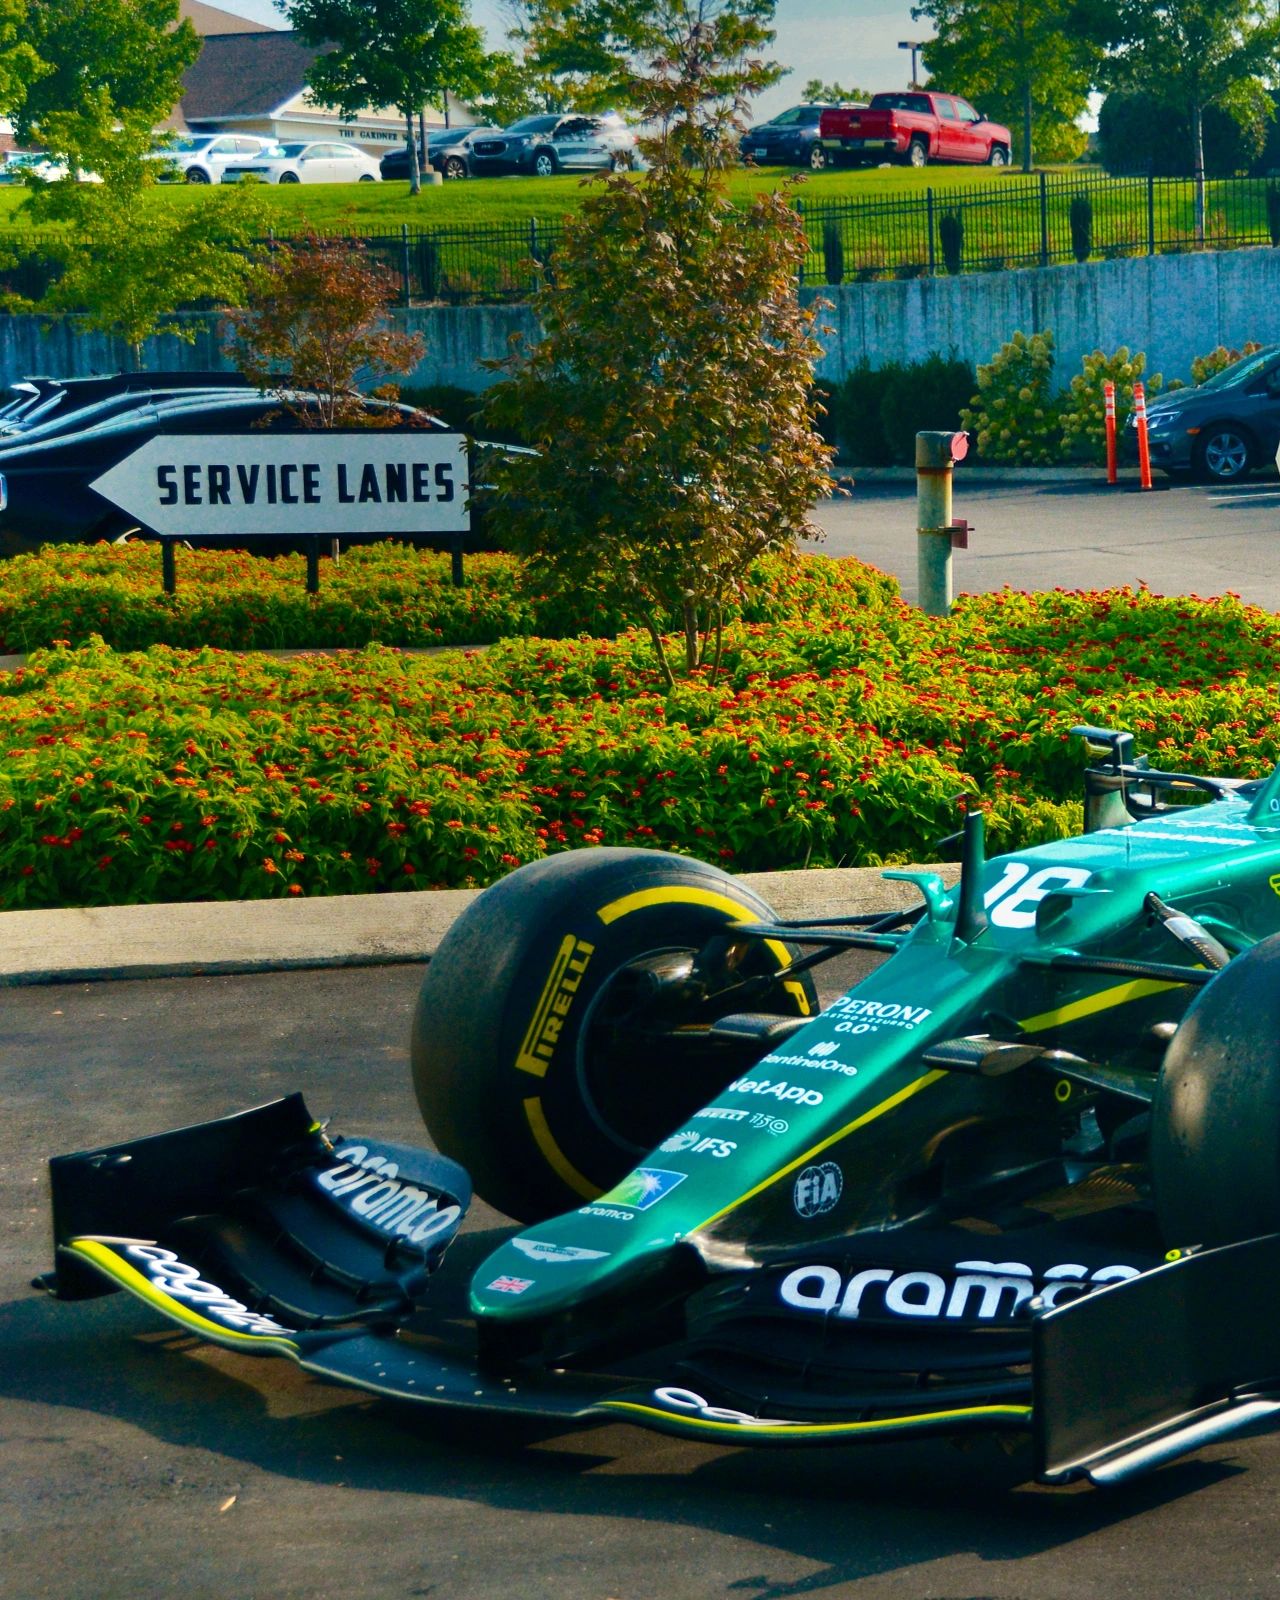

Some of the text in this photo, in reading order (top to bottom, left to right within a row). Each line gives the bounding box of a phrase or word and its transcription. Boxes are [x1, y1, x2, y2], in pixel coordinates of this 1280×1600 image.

[157, 463, 454, 505] SERVICE LANES
[514, 934, 595, 1078] PIRELLI
[827, 996, 932, 1025] PERONI
[691, 1137, 738, 1158] IFS
[318, 1146, 462, 1242] aramco
[578, 1206, 635, 1220] aramco
